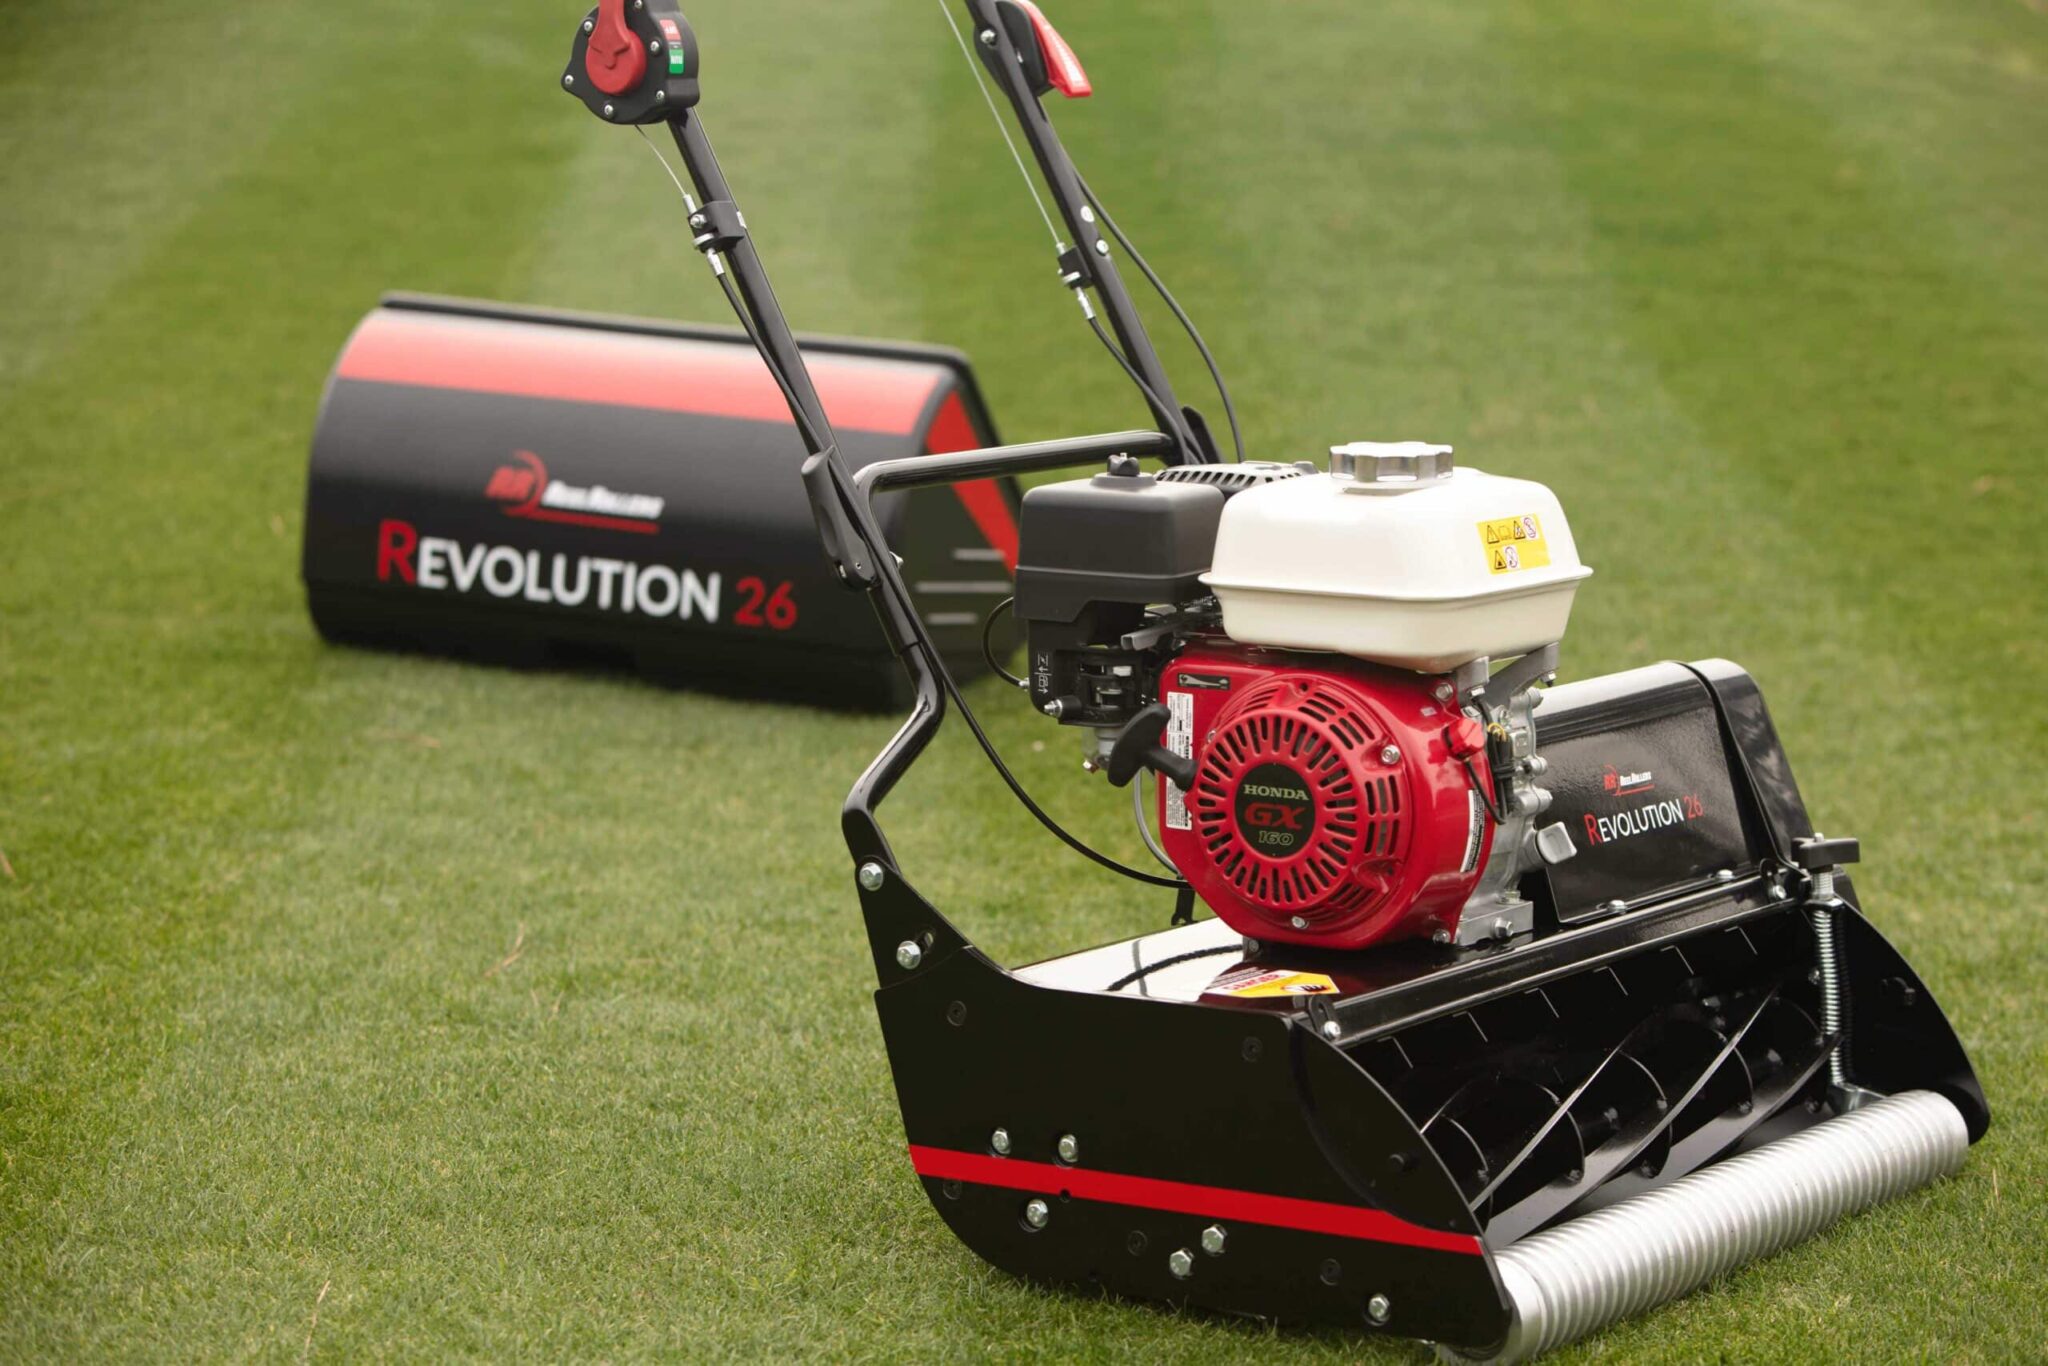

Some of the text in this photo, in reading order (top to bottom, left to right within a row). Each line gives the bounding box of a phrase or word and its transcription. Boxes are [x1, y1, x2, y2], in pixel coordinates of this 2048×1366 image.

[378, 520, 797, 628] REVOLUTION 26
[1244, 785, 1309, 800] HONDA
[1245, 803, 1305, 829] GX
[1585, 795, 1703, 845] REVOLUTION 26
[1259, 831, 1294, 846] 160
